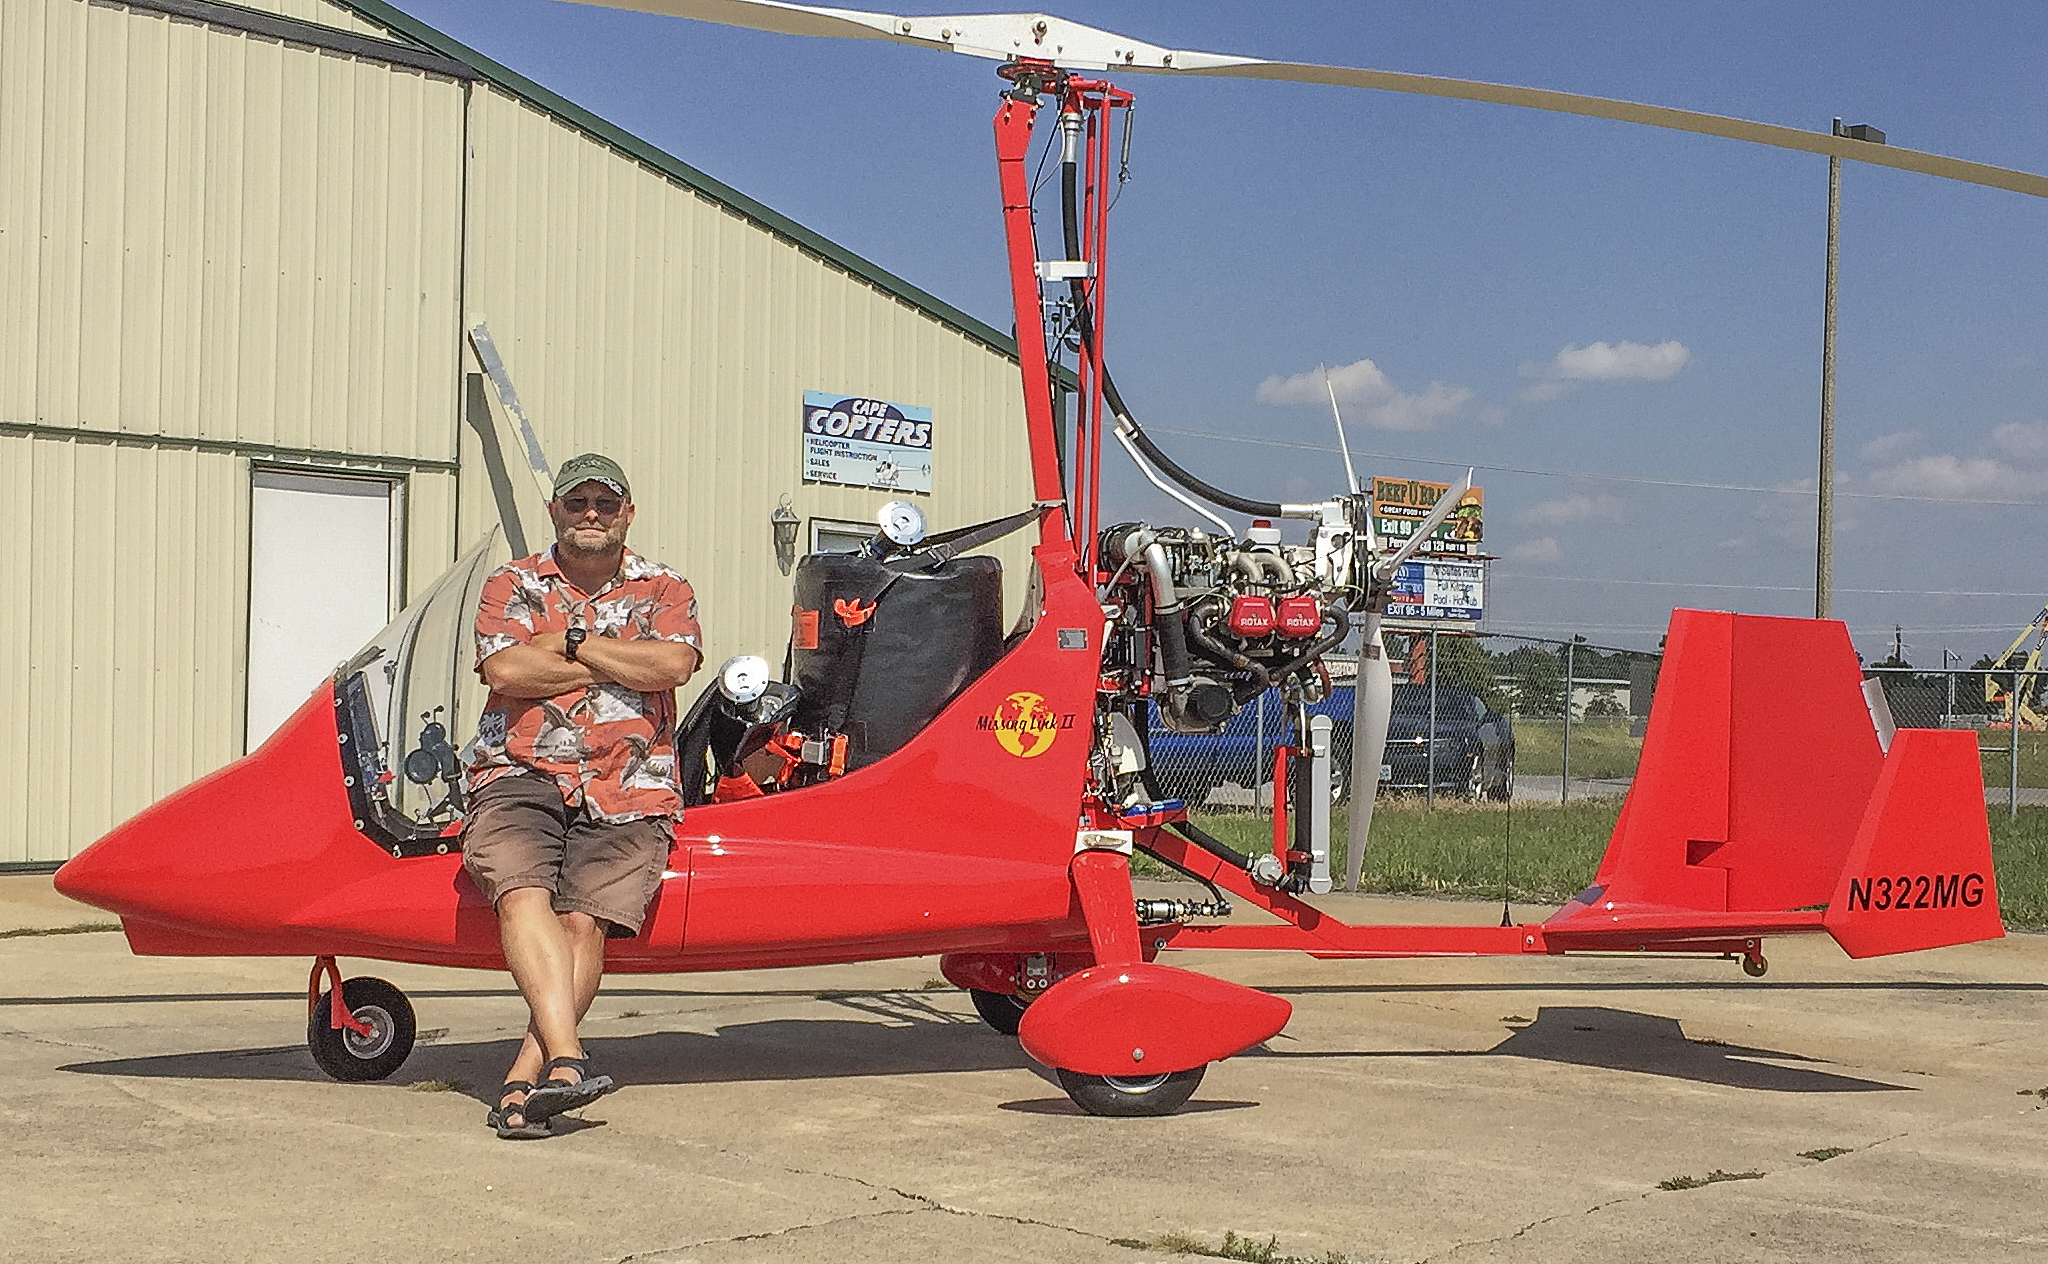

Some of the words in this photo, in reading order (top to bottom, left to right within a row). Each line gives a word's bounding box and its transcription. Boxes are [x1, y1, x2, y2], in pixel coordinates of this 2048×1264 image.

[852, 399, 889, 417] CAPE
[809, 409, 931, 447] COPTERS
[810, 438, 850, 449] HELICOPTER
[810, 446, 833, 456] FLIGHT
[834, 450, 878, 462] INSTRUCTION
[810, 458, 830, 467] SALES
[810, 470, 837, 480] SERVICE
[1381, 519, 1399, 534] Exit
[1400, 520, 1412, 535] 99
[1433, 593, 1447, 605] Pool
[1387, 604, 1405, 615] EXIT
[1420, 606, 1425, 617] 5
[1240, 618, 1268, 626] ROTAX
[1286, 618, 1314, 626] ROTAX
[976, 714, 1027, 734] Missing
[1029, 713, 1058, 732] Link
[1060, 714, 1076, 729] II
[1847, 873, 1985, 912] N322MG
